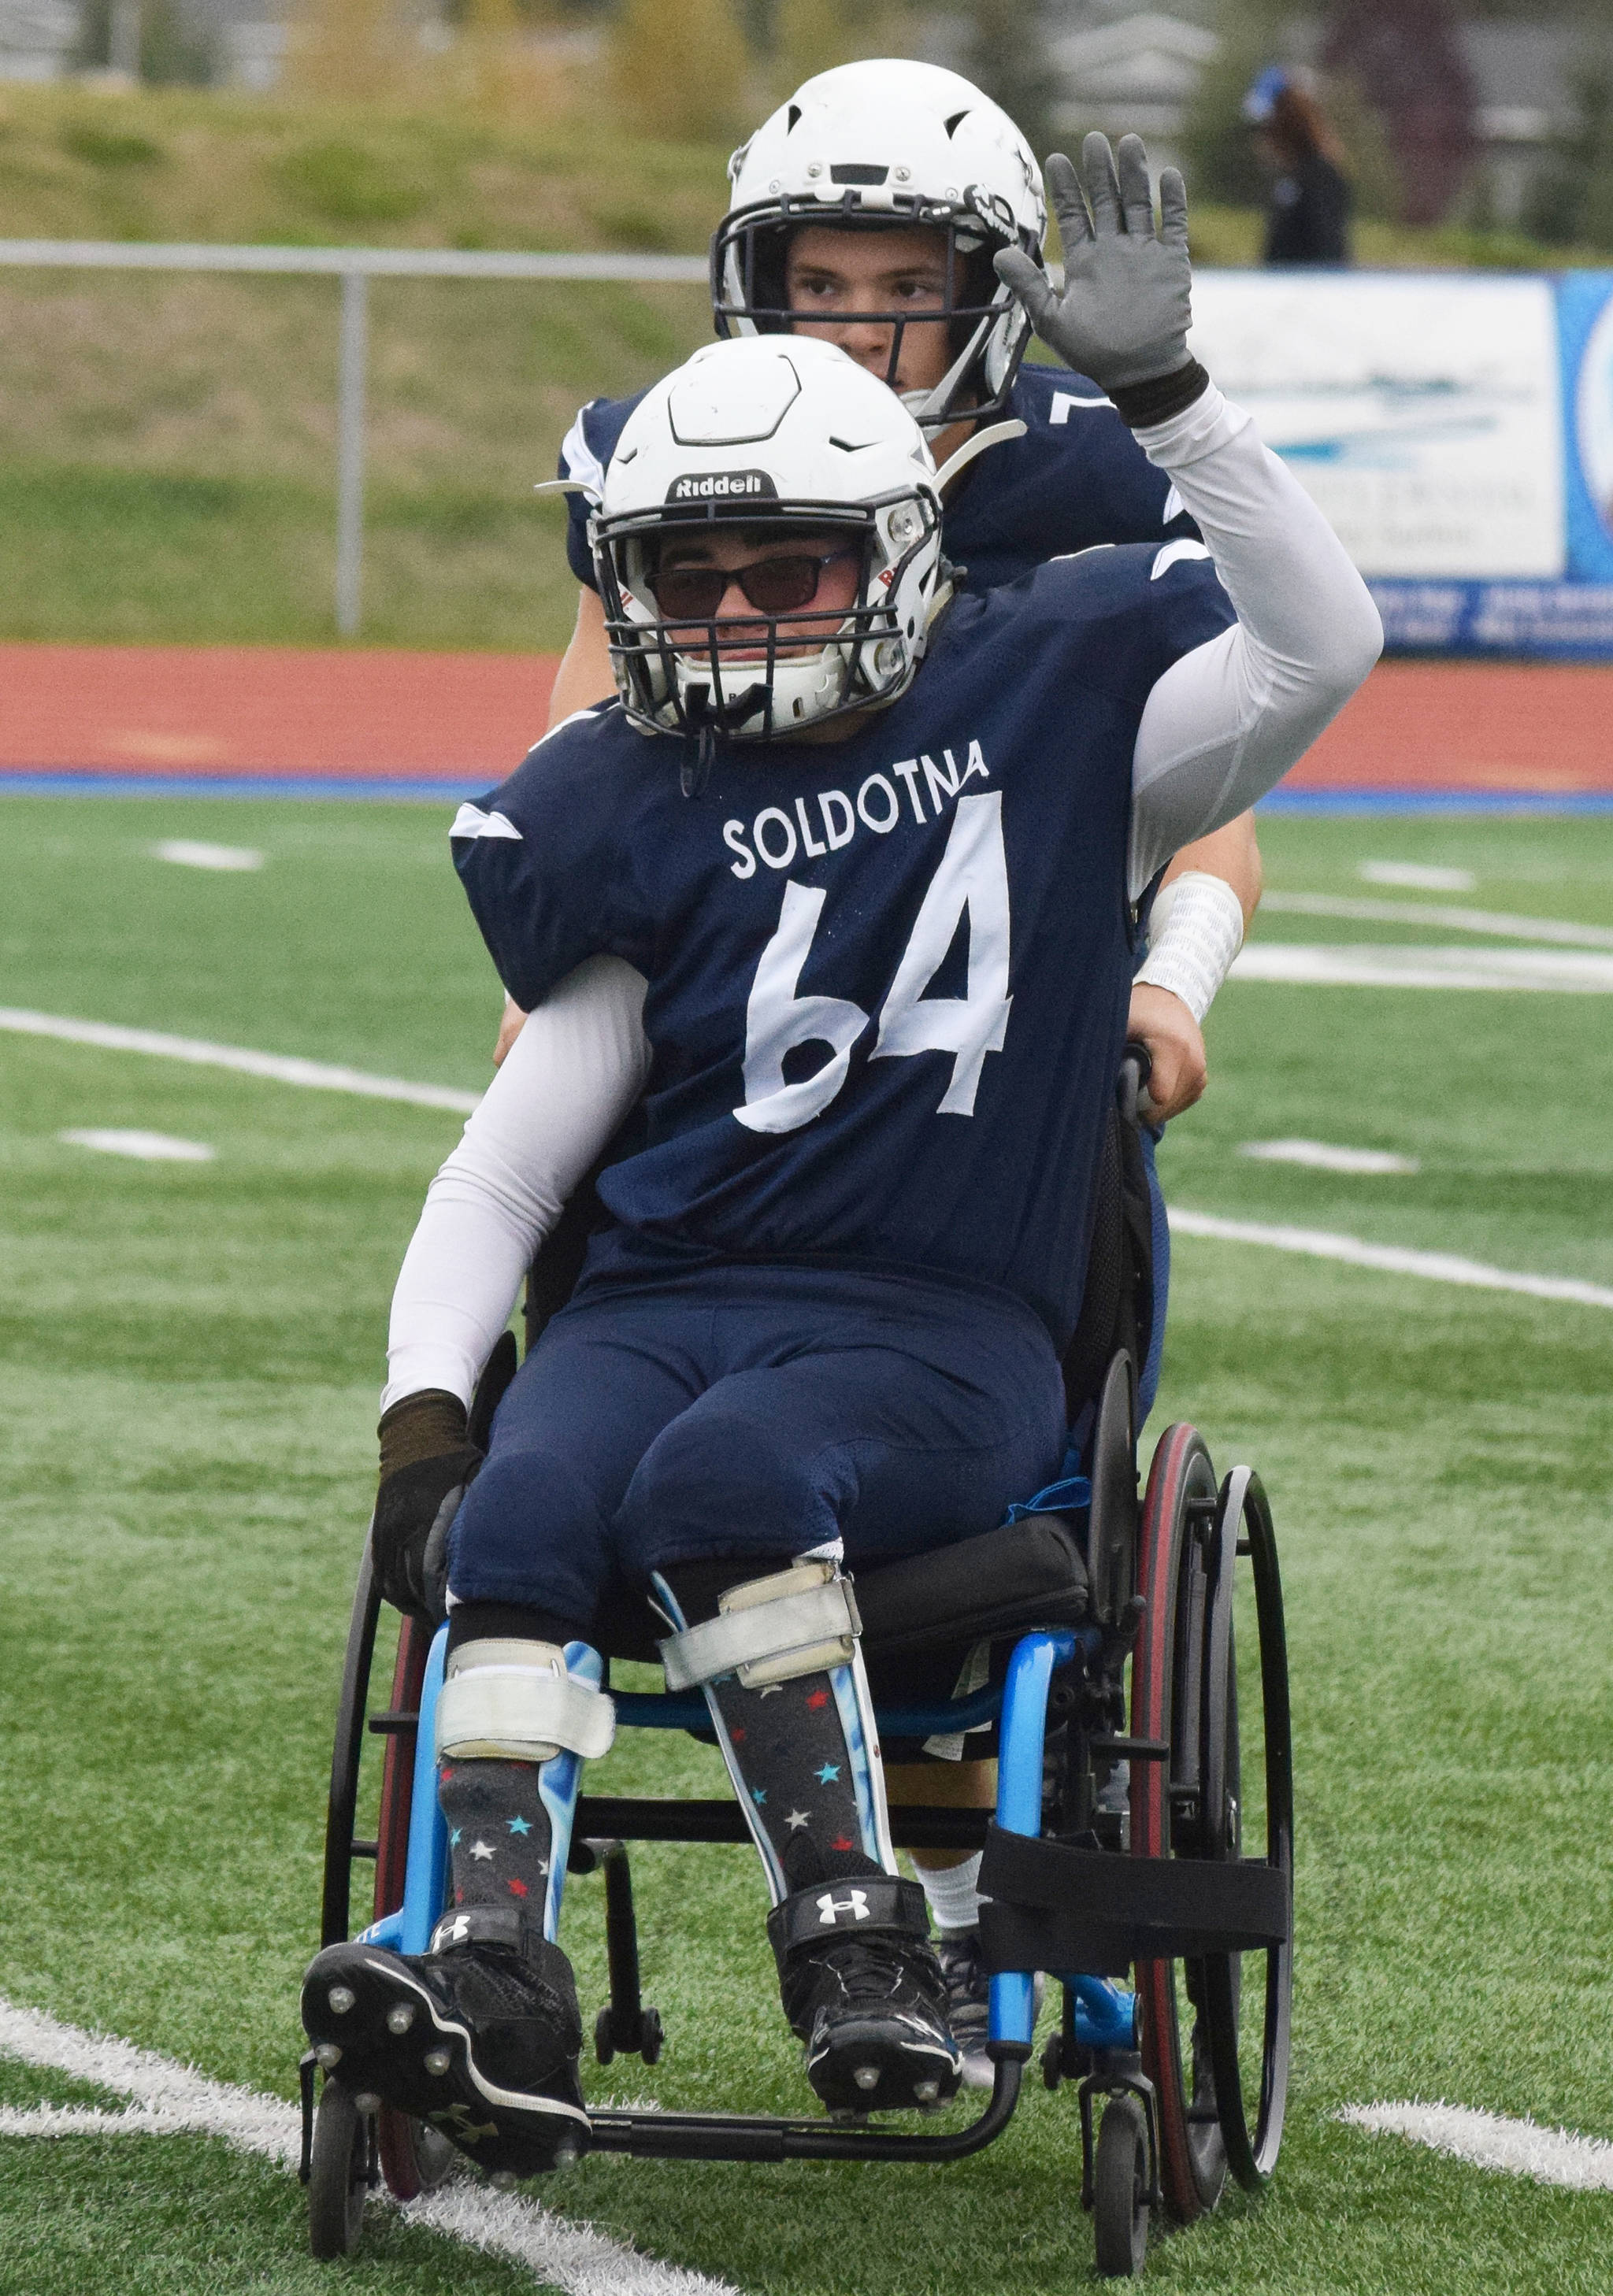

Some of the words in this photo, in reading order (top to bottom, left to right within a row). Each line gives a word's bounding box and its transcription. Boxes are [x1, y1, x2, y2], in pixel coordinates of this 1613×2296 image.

[676, 475, 762, 498] Riddell
[723, 739, 990, 880] SOLDOTNA
[732, 790, 1014, 1134] 64
